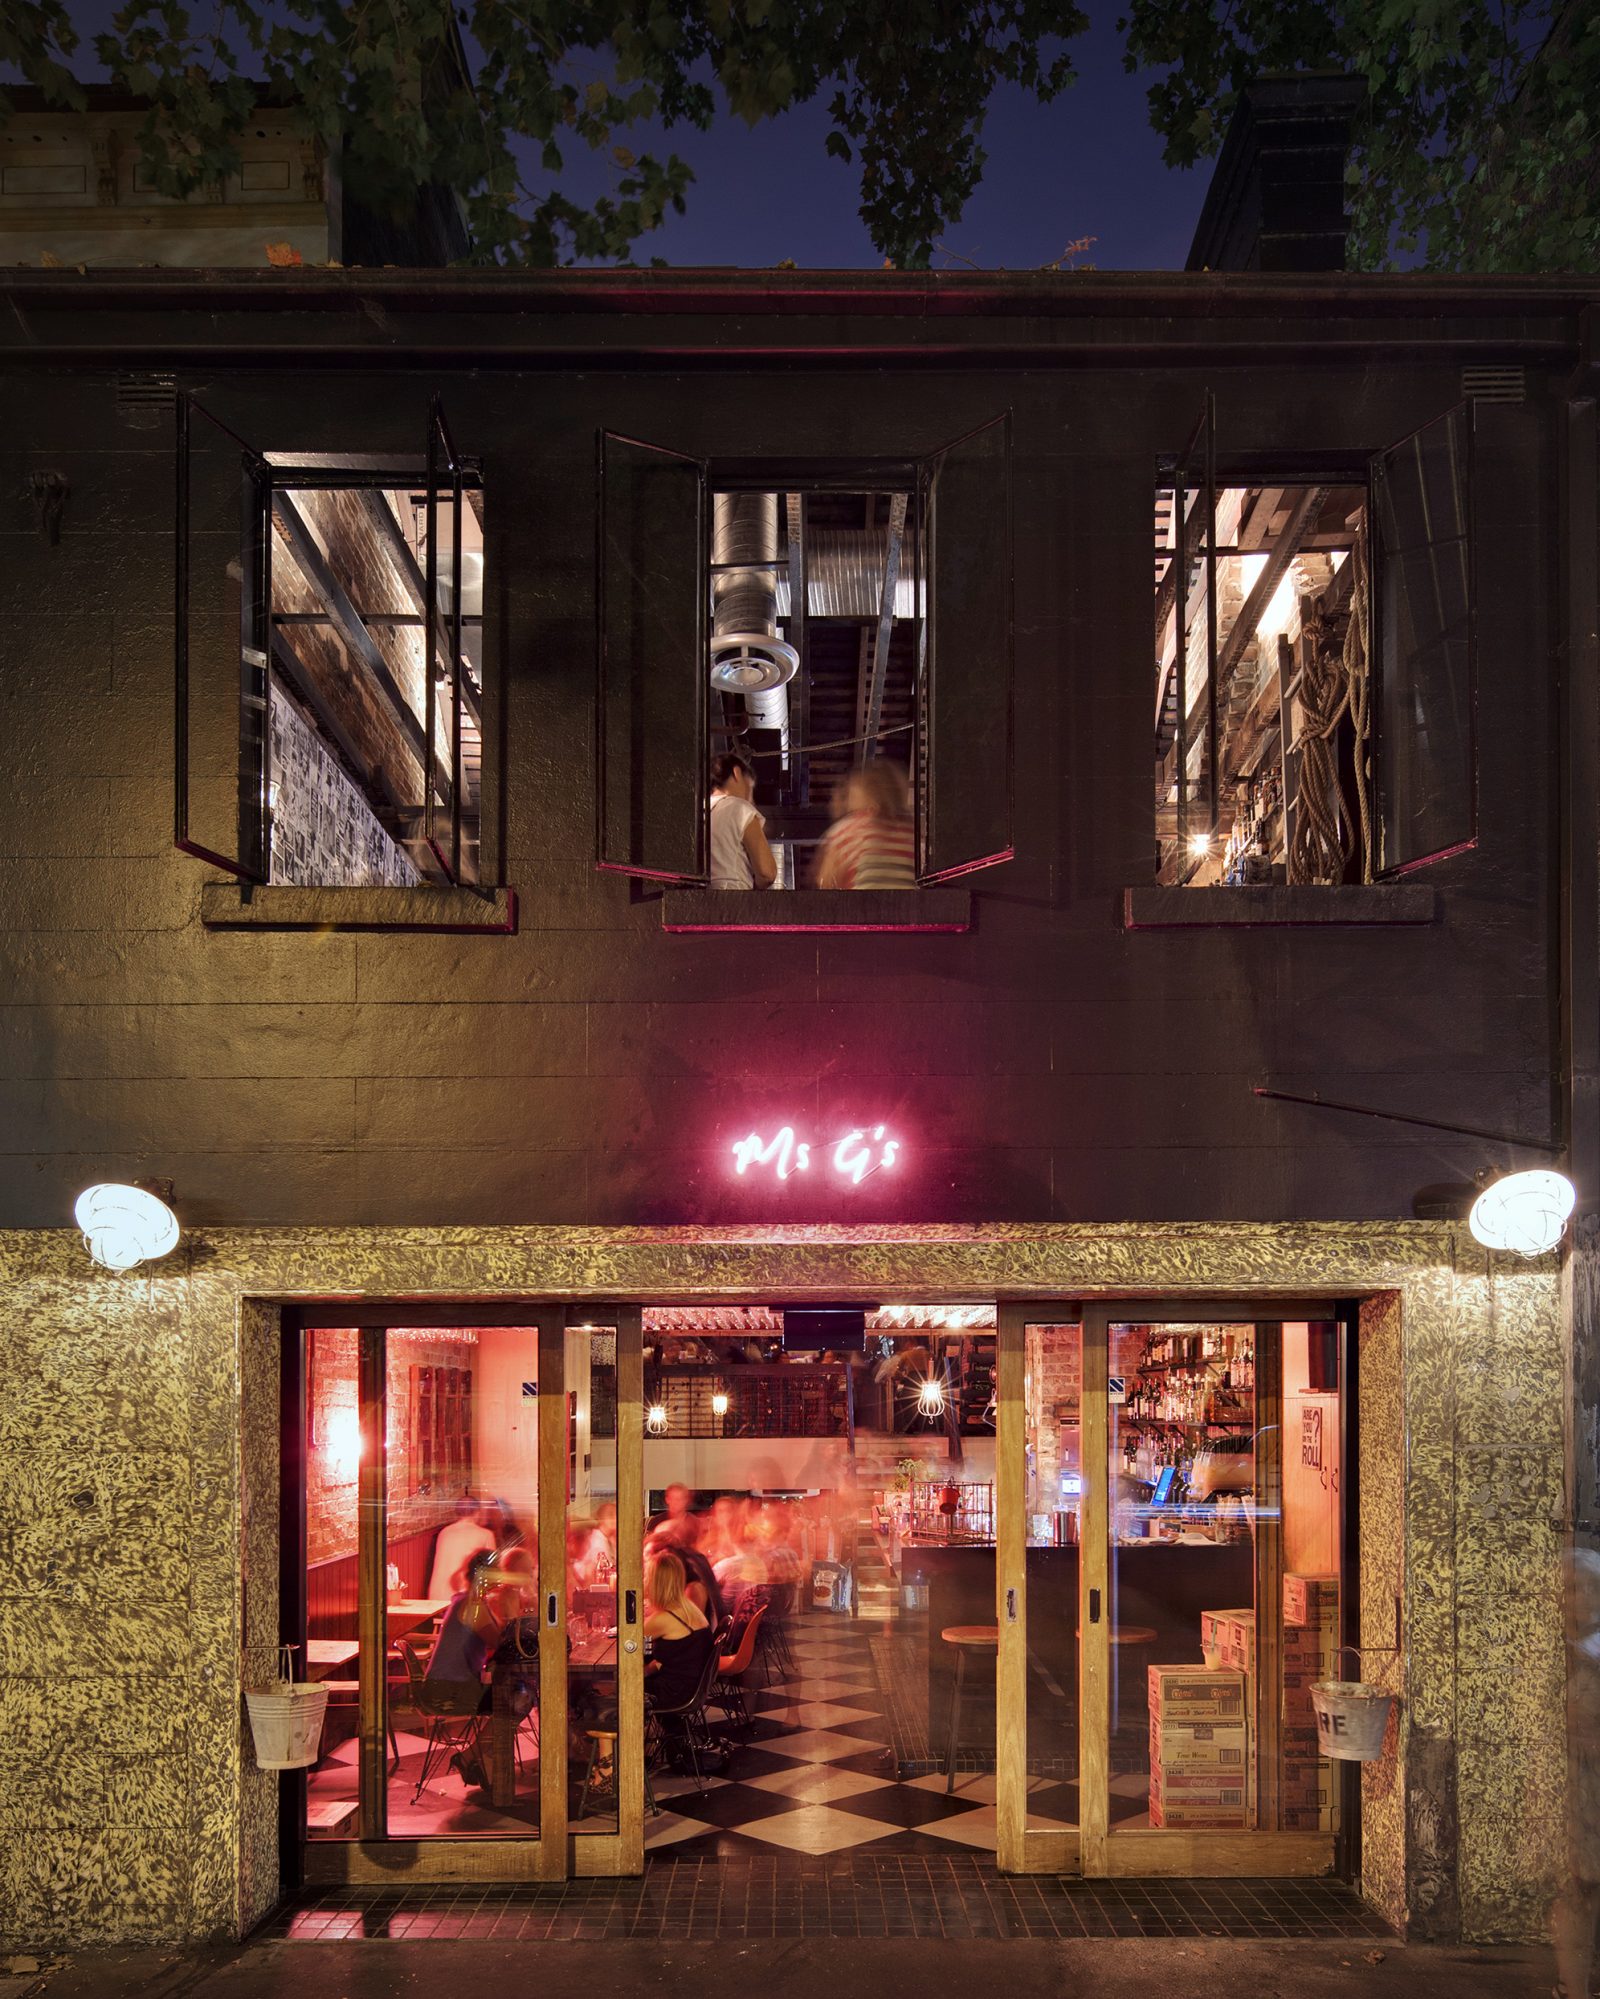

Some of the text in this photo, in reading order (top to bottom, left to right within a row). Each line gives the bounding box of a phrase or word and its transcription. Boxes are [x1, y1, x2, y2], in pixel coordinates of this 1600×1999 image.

[732, 1124, 900, 1185] Ms G's
[1303, 1409, 1312, 1420] ARE
[1302, 1445, 1319, 1467] ROLL
